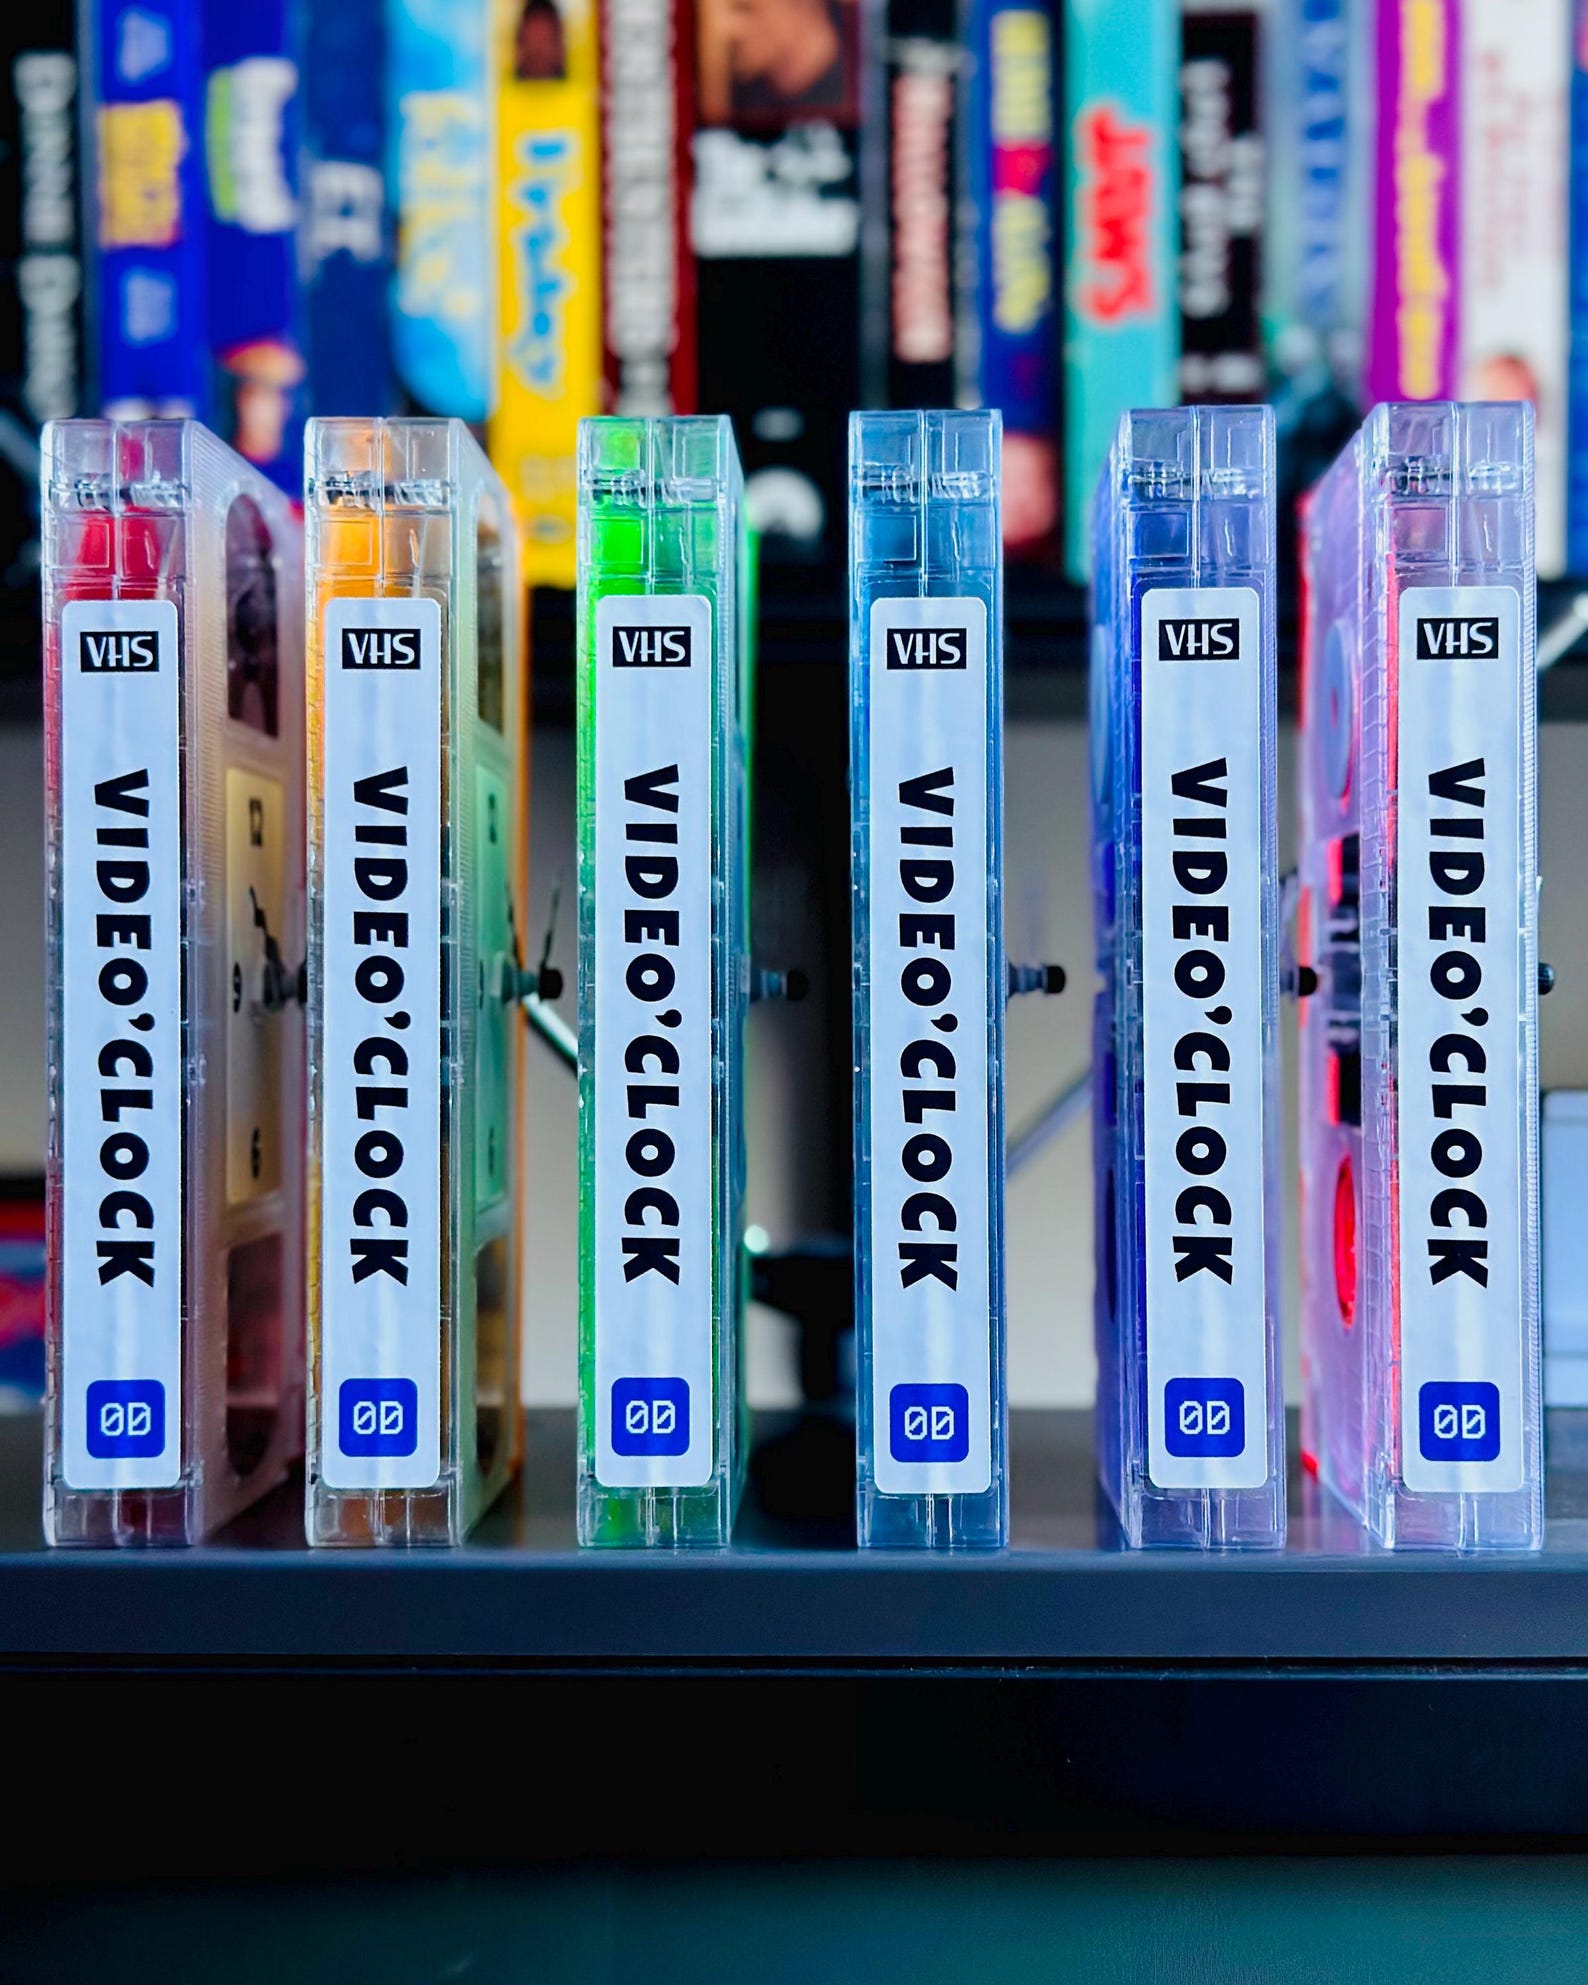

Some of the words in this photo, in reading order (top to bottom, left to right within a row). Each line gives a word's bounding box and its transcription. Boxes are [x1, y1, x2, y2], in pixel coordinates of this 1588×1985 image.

[87, 636, 153, 667] VHS
[348, 633, 414, 664] VHS
[619, 631, 685, 662] VHS
[894, 633, 960, 664] VHS
[1166, 624, 1233, 655] VHS
[1424, 623, 1492, 654] VHS
[95, 769, 154, 1287] VIDEO'CLOCK
[350, 767, 410, 1286] VIDEO'CLOCK
[622, 764, 681, 1285] VIDEO'CLOCK
[899, 767, 957, 1291] VIDEO'CLOCK
[1172, 758, 1232, 1285] VIDEO'CLOCK
[1428, 758, 1488, 1288] VIDEO'CLOCK
